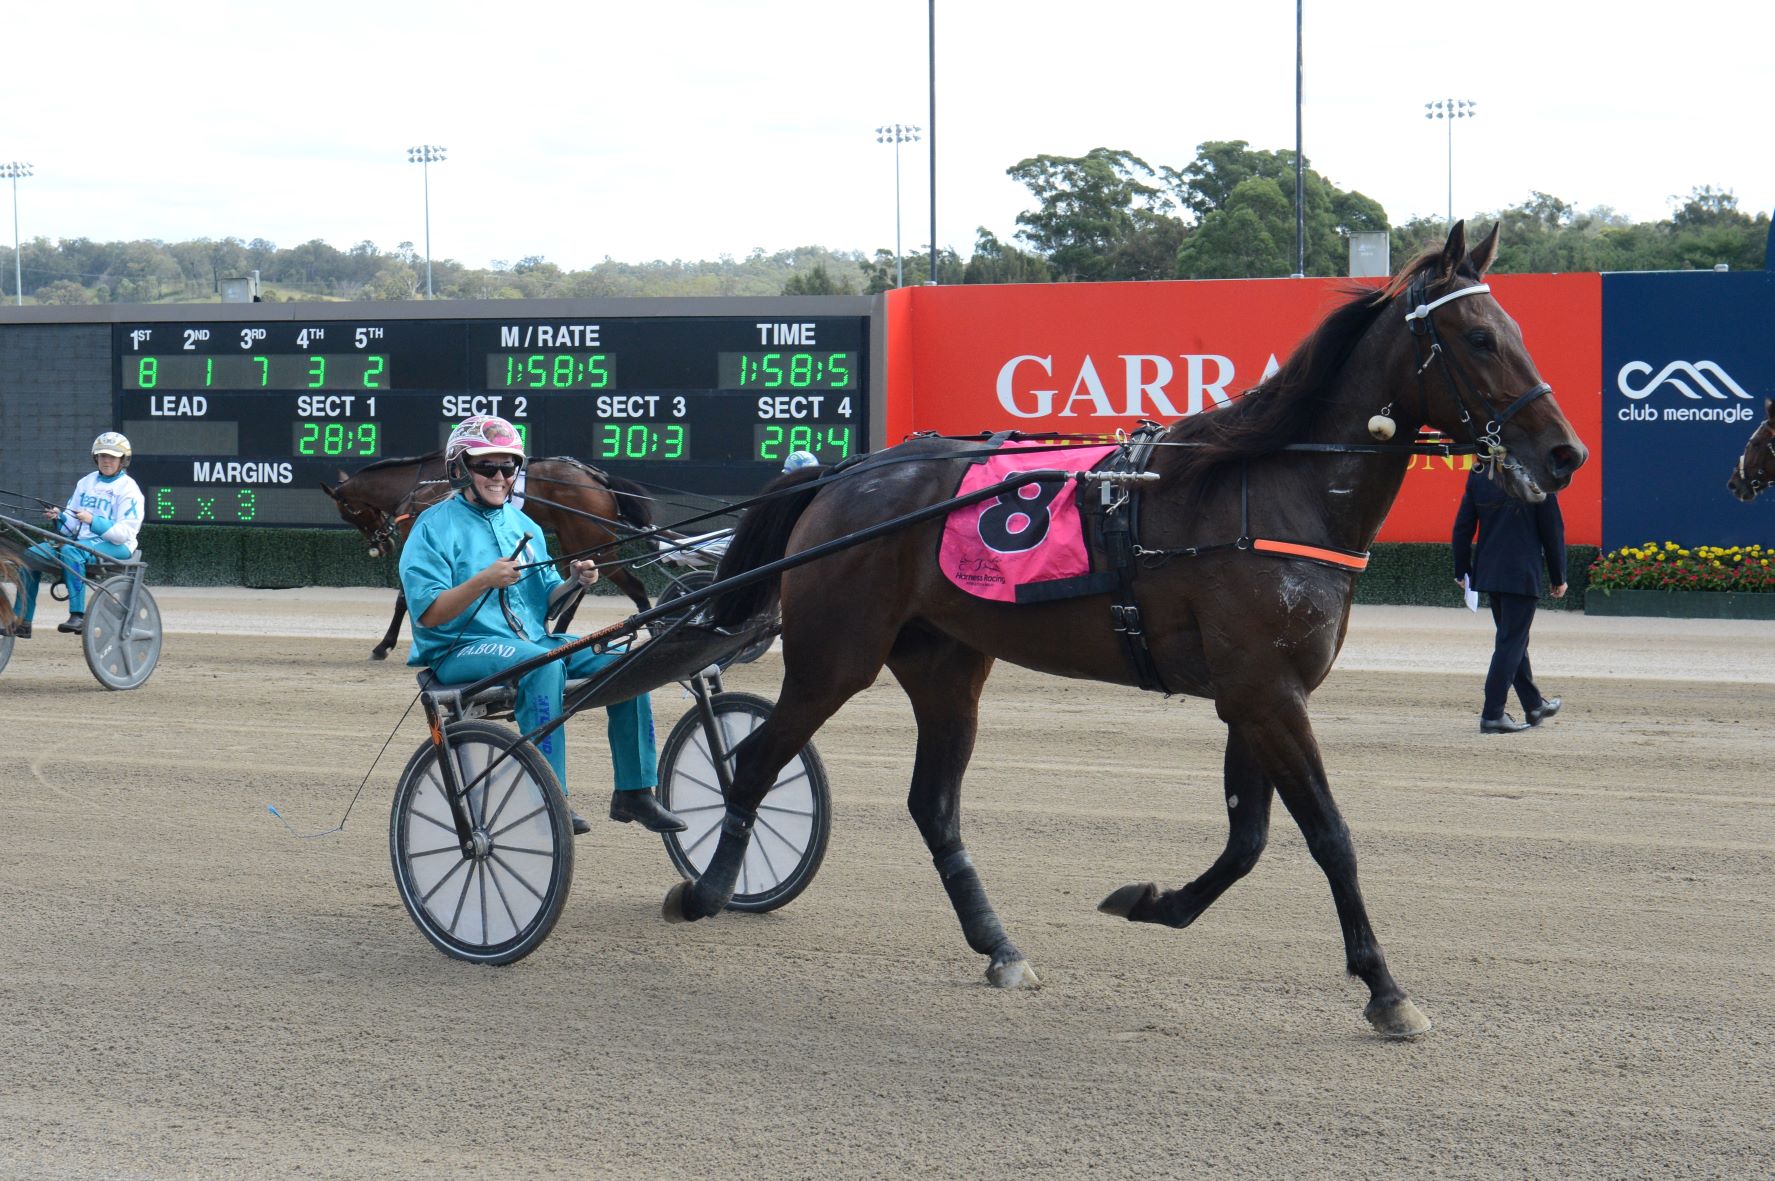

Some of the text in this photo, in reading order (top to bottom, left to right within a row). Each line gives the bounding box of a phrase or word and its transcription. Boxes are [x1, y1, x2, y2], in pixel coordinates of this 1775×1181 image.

[130, 328, 383, 350] 1ST 2ND 3RD 4TH 5TH
[757, 324, 816, 346] TIME
[138, 355, 384, 389] 8 1 7 3 2
[150, 396, 208, 417] LEAD
[298, 396, 376, 417] SECT 1
[442, 396, 528, 417] SECT 2
[597, 396, 686, 418] SECT 3
[758, 396, 852, 419] SECT 4
[1618, 403, 1754, 424] club menangle
[193, 462, 293, 484] MARGINS
[157, 488, 177, 520] 6
[237, 489, 256, 521] 3
[977, 468, 1066, 554] 8
[955, 571, 983, 583] Harness
[984, 573, 1006, 585] Racing
